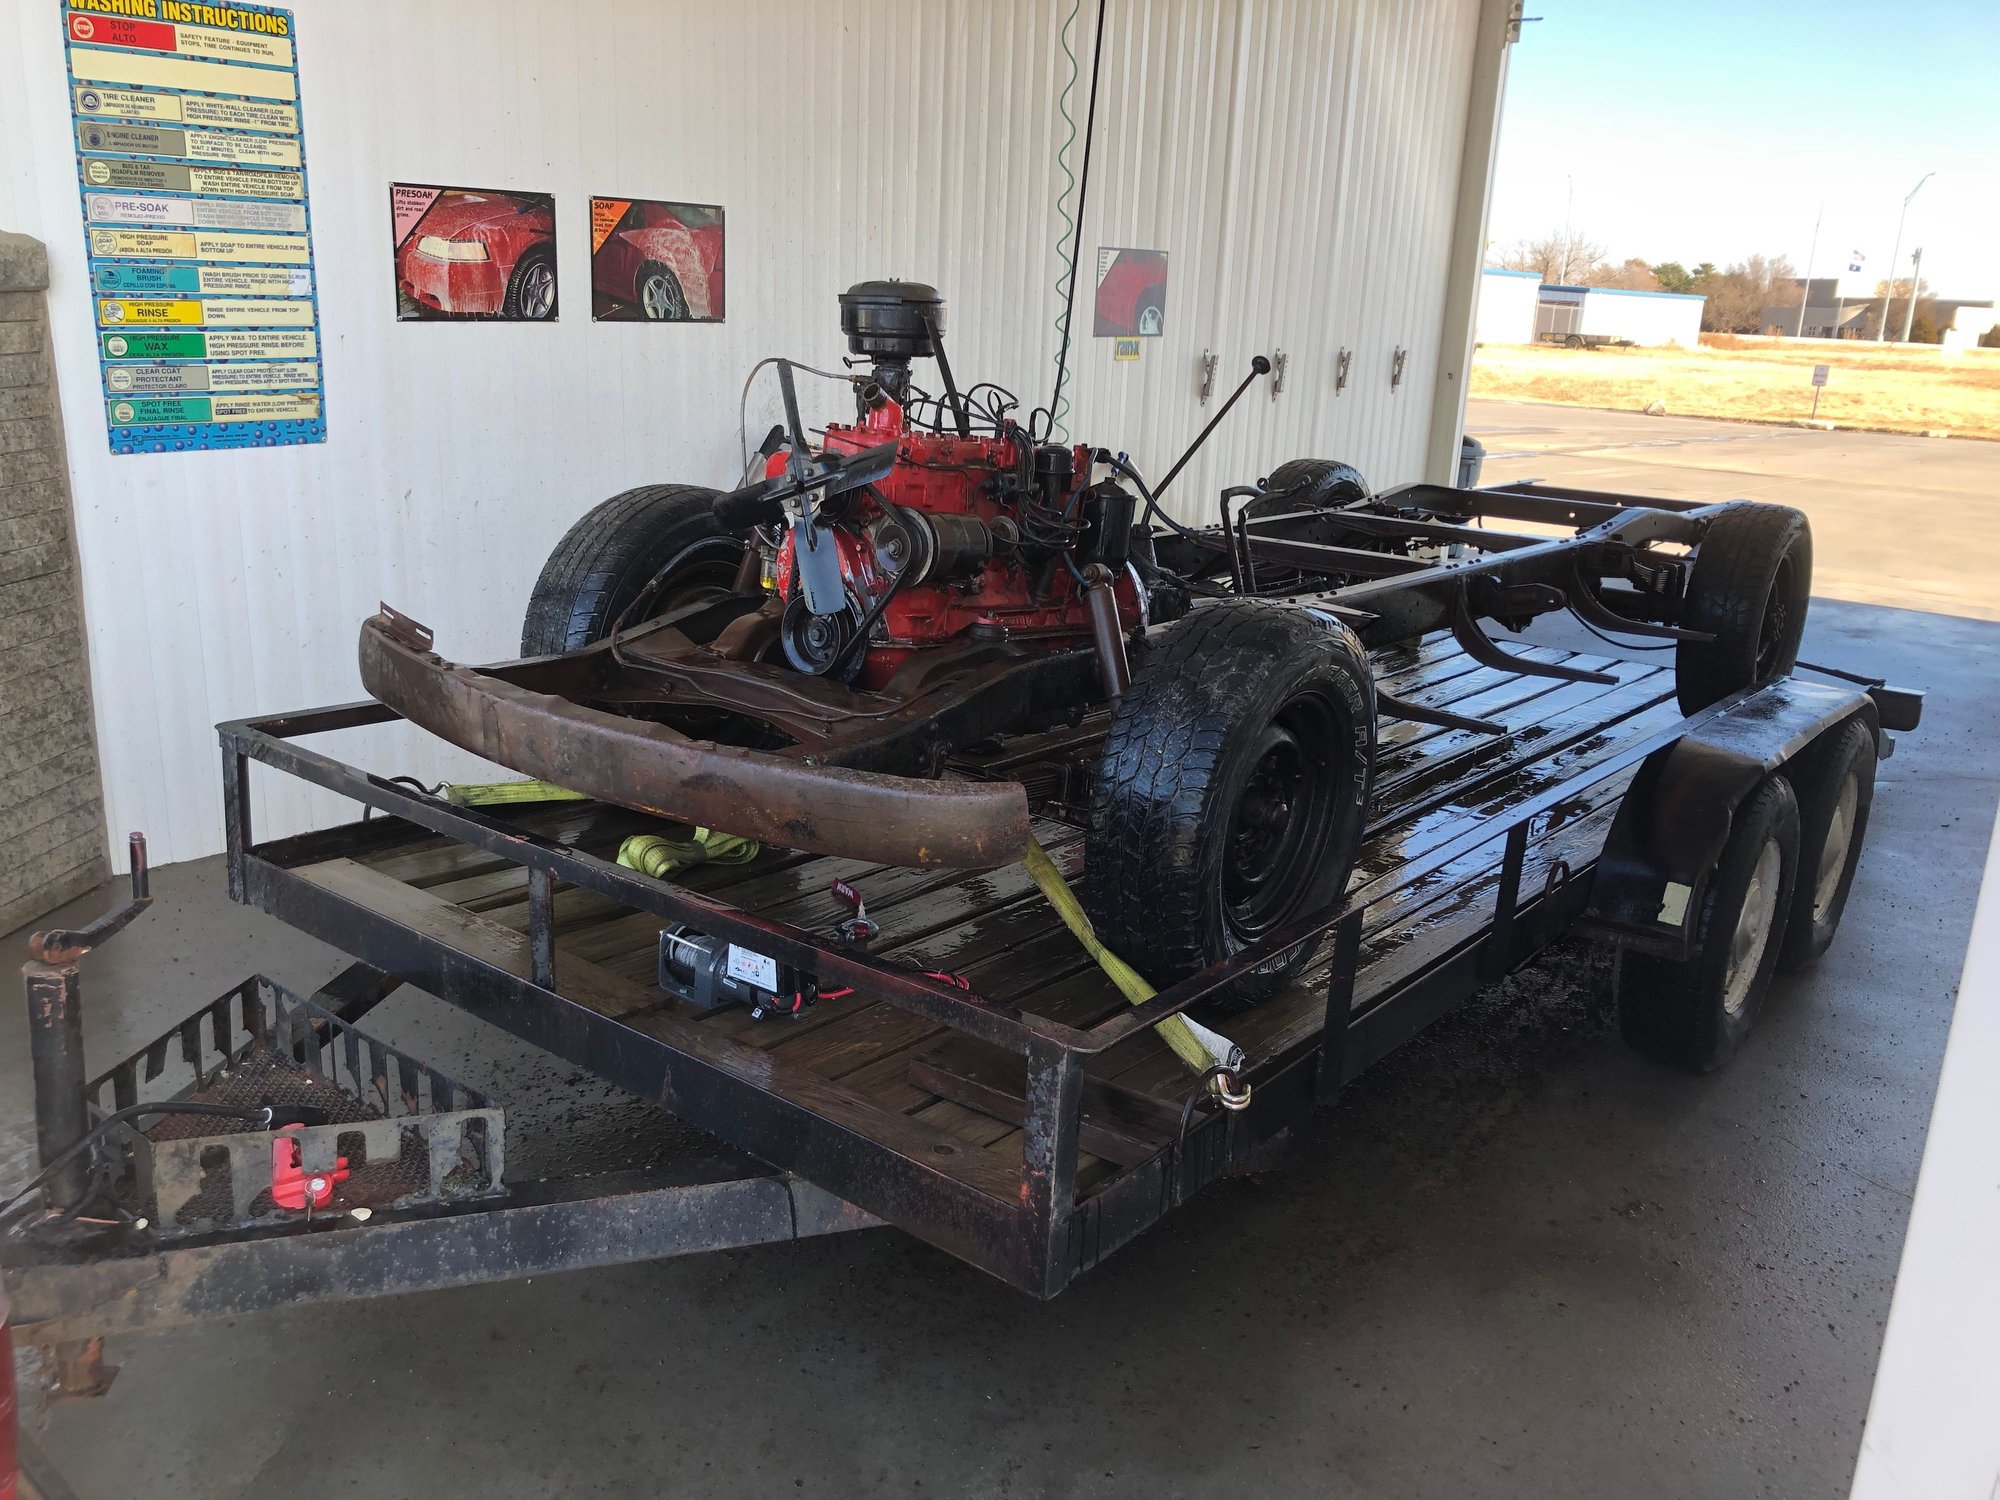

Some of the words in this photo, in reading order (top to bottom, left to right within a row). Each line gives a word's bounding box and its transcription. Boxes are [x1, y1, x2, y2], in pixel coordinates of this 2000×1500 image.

[161, 0, 288, 36] INSTRUCTIONS
[110, 21, 136, 31] STOP
[112, 33, 136, 43] ALTO
[204, 36, 230, 44] FEATURE
[236, 40, 268, 48] EQUIPMENT
[219, 45, 251, 53] CONTINUES
[121, 95, 155, 103] CLEANER
[206, 103, 240, 111] WHITE-WALL
[107, 132, 129, 140] ENGINE
[396, 189, 432, 199] PRESOAK
[594, 202, 614, 210] SOAP
[137, 309, 168, 317] RINSE
